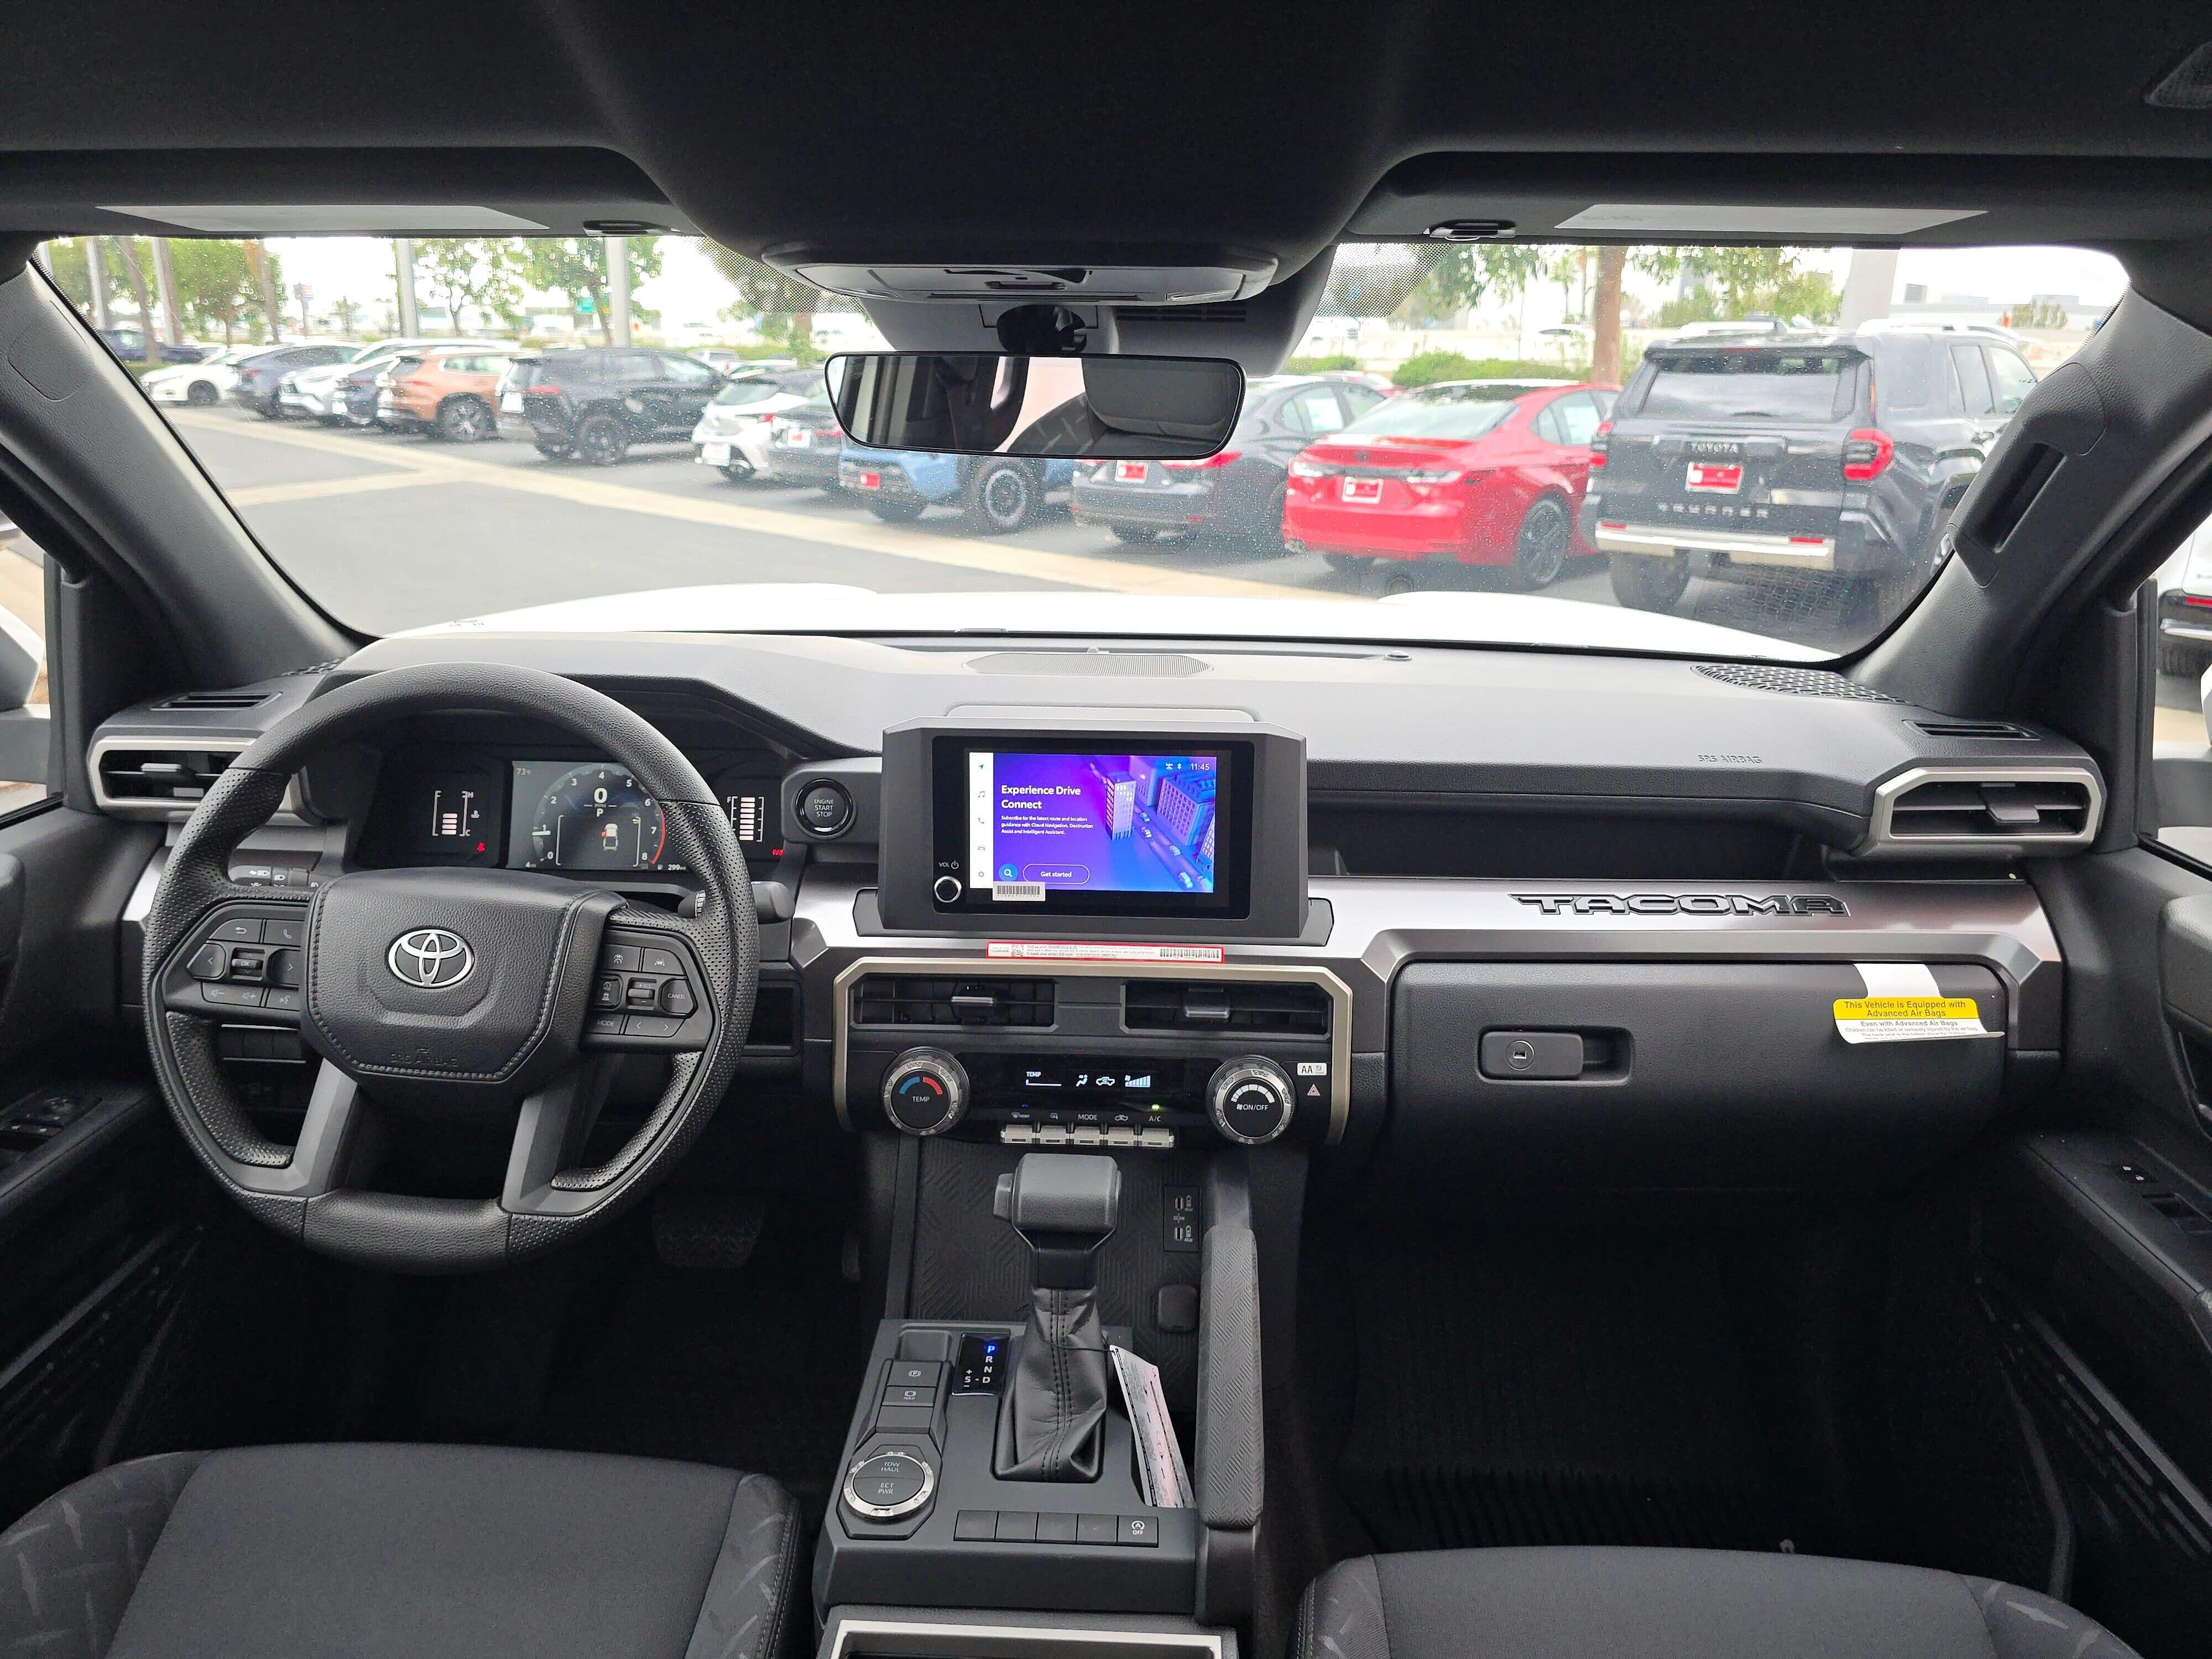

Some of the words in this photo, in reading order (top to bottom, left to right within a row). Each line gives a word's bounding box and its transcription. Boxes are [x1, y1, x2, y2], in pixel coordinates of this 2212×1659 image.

[626, 779, 632, 787] 5
[1001, 785, 1054, 796] Experience
[1056, 785, 1081, 795] Drive
[594, 787, 608, 804] 0
[550, 796, 557, 804] 2
[645, 798, 651, 806] 6
[1001, 799, 1042, 808] Connect
[596, 808, 603, 817] P
[650, 826, 657, 834] 7
[547, 851, 554, 859] 0
[641, 852, 648, 860] 8
[1506, 893, 1851, 917] TACOMA
[1906, 1001, 1946, 1010] Equipped
[1924, 1009, 1946, 1018] Bags
[1301, 1065, 1313, 1073] AA
